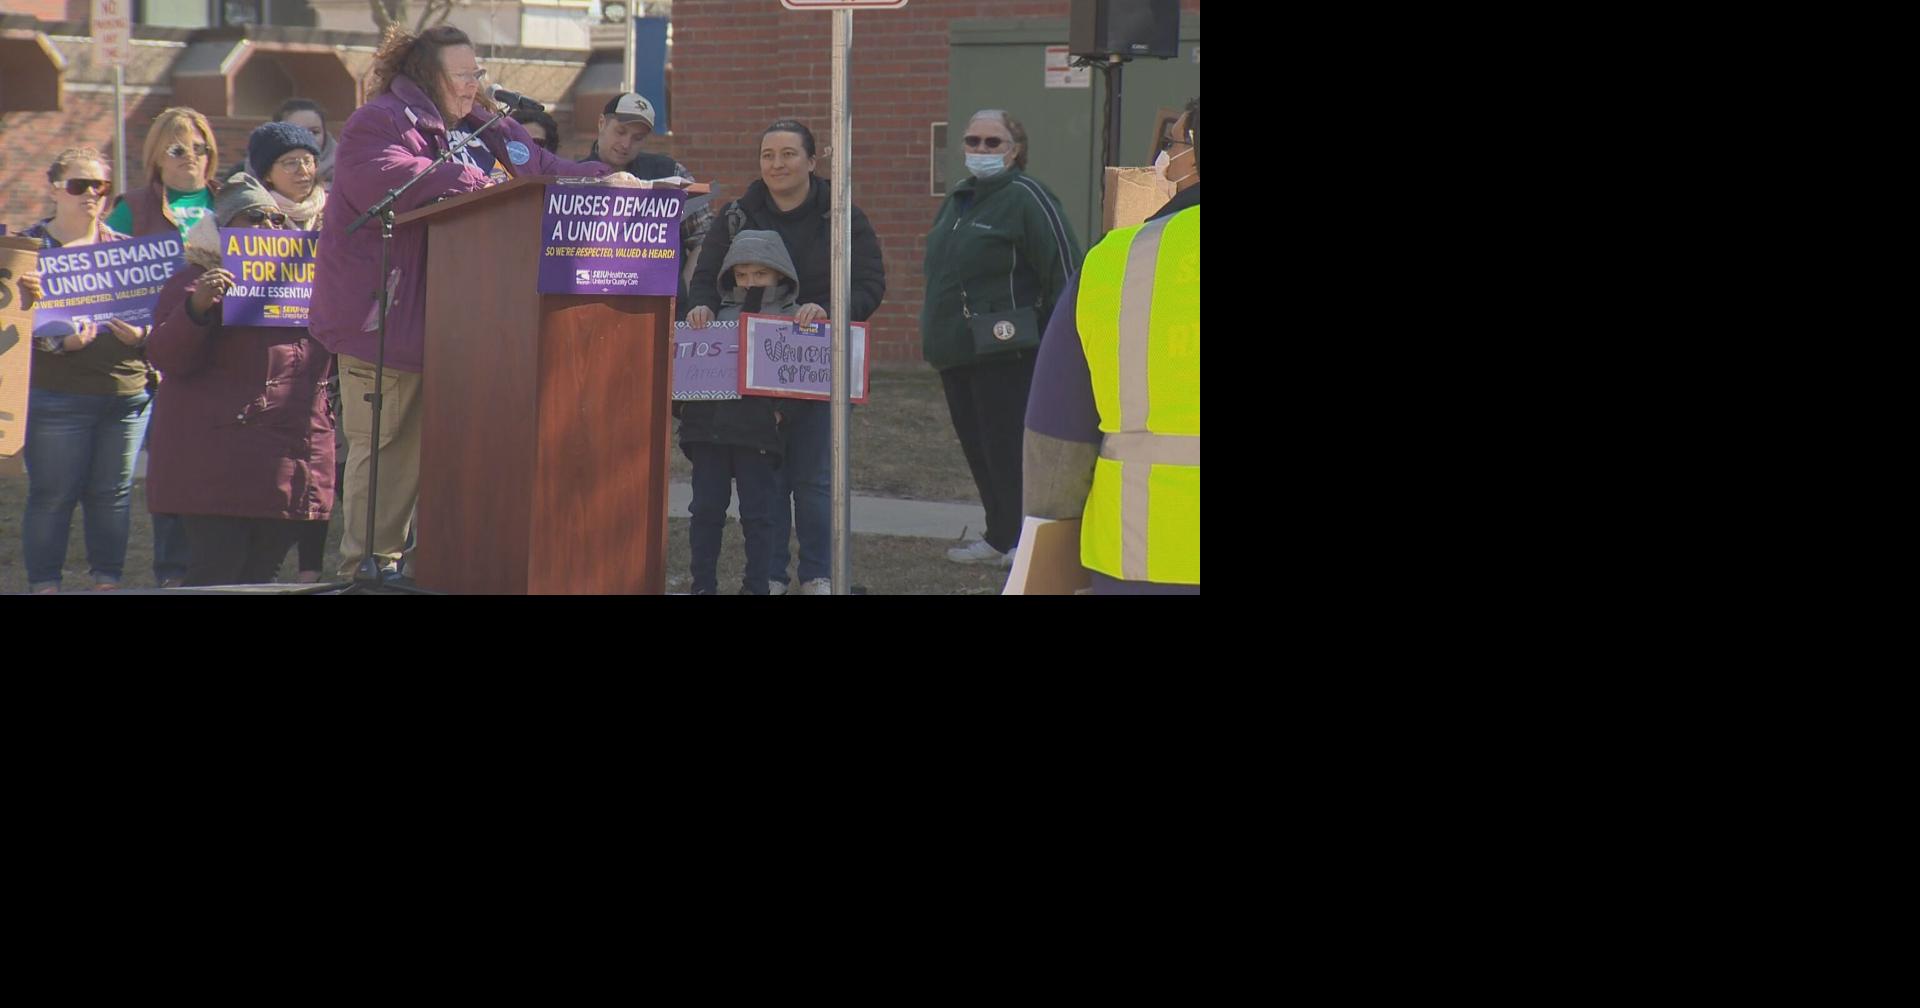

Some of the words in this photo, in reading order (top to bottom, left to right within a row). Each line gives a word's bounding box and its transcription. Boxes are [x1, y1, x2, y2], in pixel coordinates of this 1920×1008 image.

[548, 194, 611, 217] NURSES
[613, 196, 680, 218] DEMAND
[552, 220, 563, 241] A
[567, 221, 619, 243] UNION
[622, 222, 668, 244] VOICE
[37, 252, 91, 275] URSES
[94, 239, 180, 269] DEMAND
[227, 235, 241, 257] A
[244, 235, 303, 258] UNION
[545, 246, 555, 257] SO
[555, 246, 576, 257] WE'RE
[615, 248, 641, 258] VALUED
[642, 248, 647, 258] &
[648, 249, 675, 259] HEARD!
[47, 271, 113, 297] UNION
[114, 262, 174, 286] VOICE
[242, 260, 277, 282] FOR
[115, 286, 148, 300] VALUED
[226, 285, 248, 297] AND
[248, 286, 266, 297] ALL
[674, 341, 723, 359] TIOS
